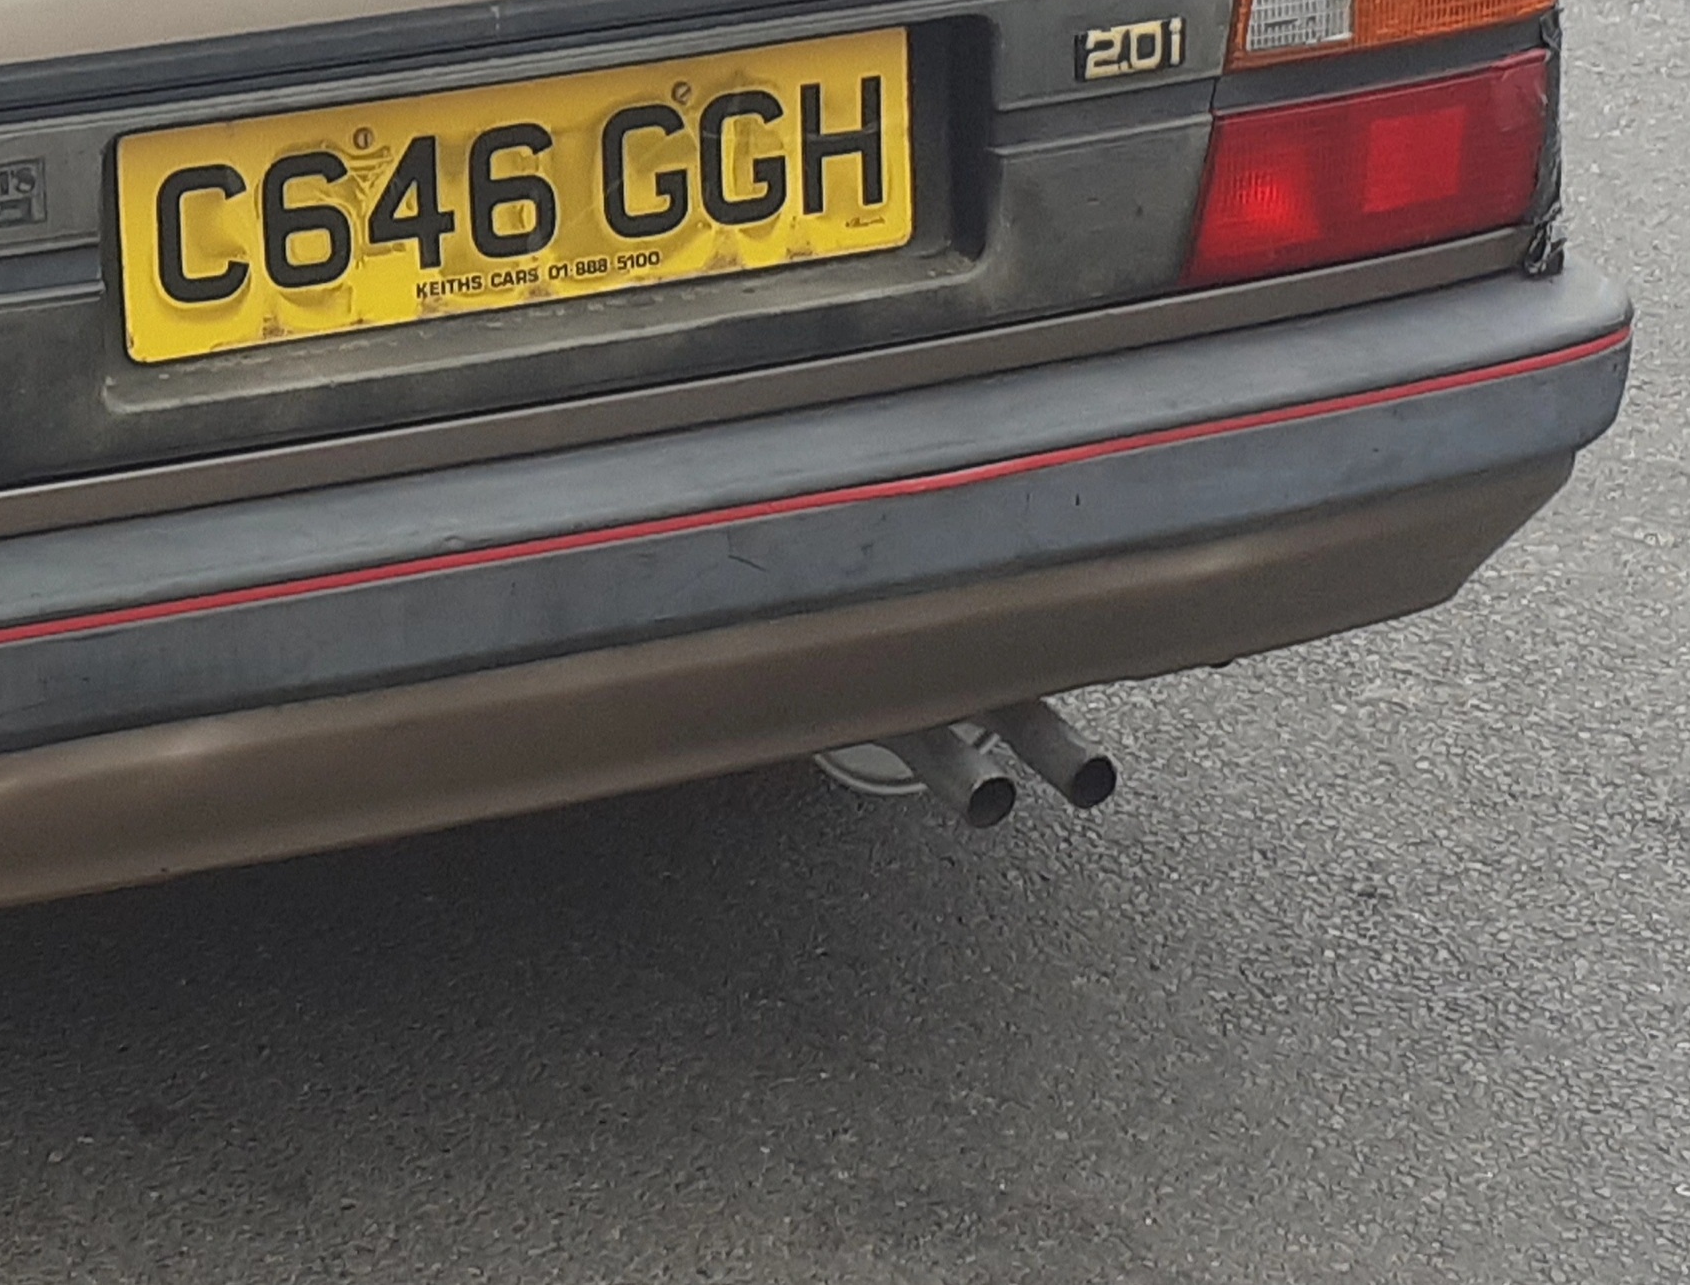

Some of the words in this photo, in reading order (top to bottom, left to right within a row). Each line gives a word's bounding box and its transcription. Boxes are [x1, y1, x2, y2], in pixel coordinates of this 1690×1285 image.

[156, 122, 557, 303] C646
[601, 75, 884, 239] GGH
[415, 275, 483, 299] KEITHS
[490, 267, 540, 288] CARS
[616, 250, 661, 271] 5100
